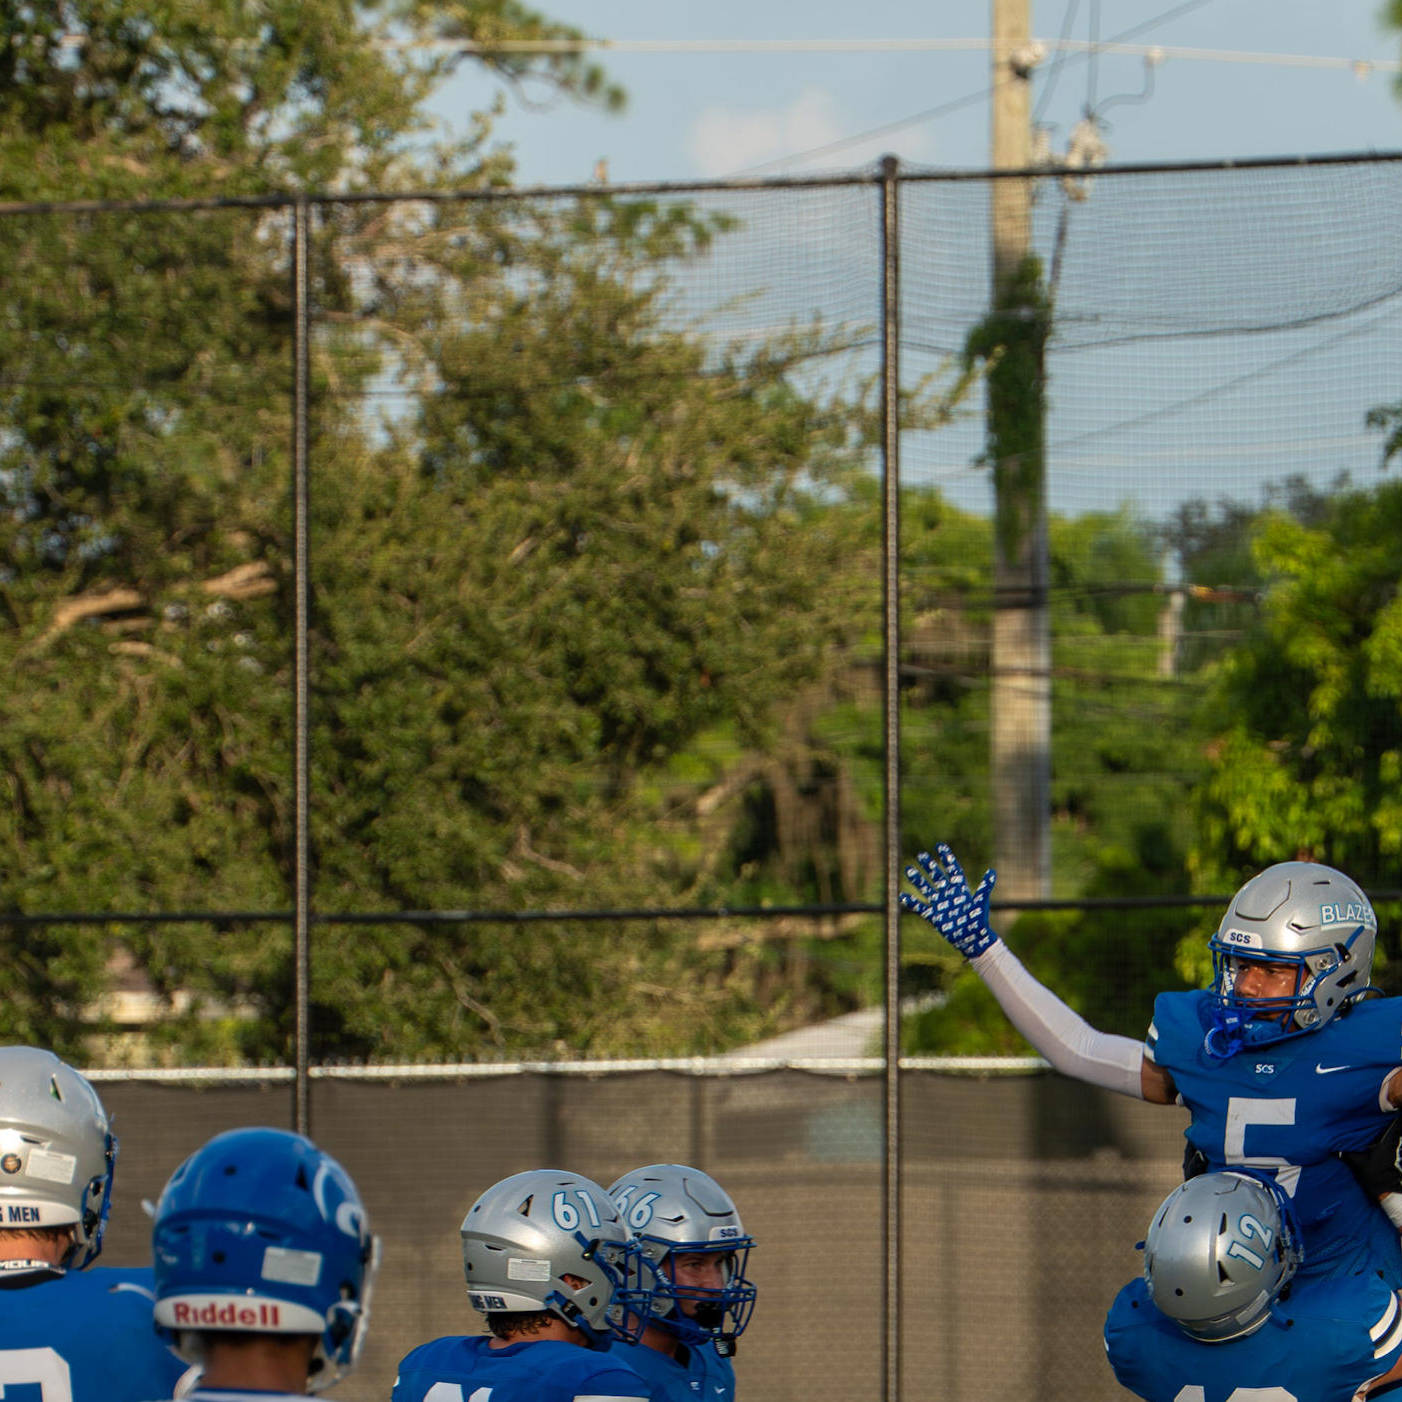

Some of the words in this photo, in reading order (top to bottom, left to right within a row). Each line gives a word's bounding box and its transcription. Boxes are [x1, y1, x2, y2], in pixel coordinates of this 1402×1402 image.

[1230, 932, 1251, 944] SCS
[1255, 1064, 1274, 1074] SCS
[1224, 1097, 1302, 1199] 5
[9, 1206, 40, 1222] MEN
[552, 1189, 601, 1231] 61
[614, 1184, 662, 1230] 66
[1227, 1213, 1274, 1271] 12
[173, 1302, 280, 1326] Riddell
[484, 1295, 508, 1309] MEN
